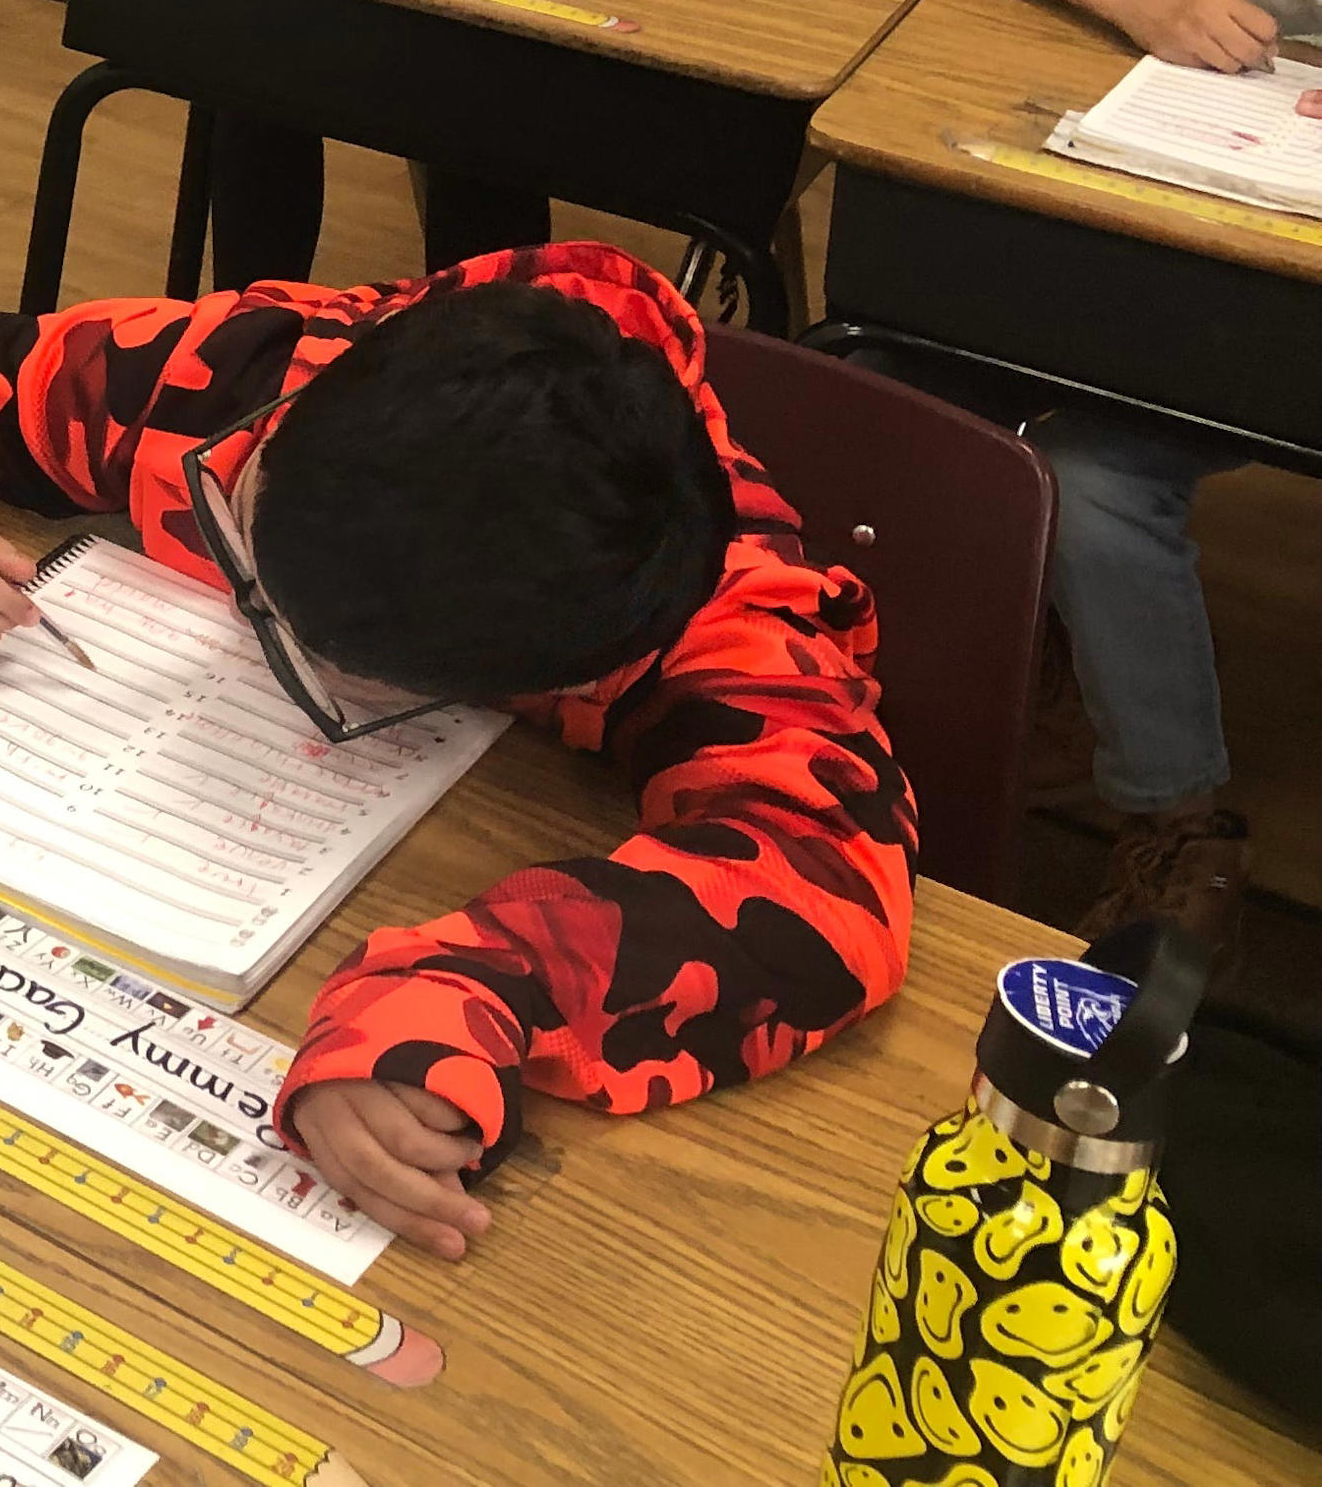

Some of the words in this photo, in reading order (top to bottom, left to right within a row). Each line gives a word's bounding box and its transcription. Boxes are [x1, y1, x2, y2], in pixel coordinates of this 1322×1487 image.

[1032, 962, 1055, 1031] LIBERTY
[1054, 977, 1075, 1030] POINT
[28, 1056, 56, 1079] Hh
[101, 1098, 128, 1120] Ff
[181, 1140, 217, 1165] Dd
[228, 1164, 259, 1187] Cc
[274, 1186, 305, 1211] Bb
[320, 1209, 350, 1233] Aa
[29, 1401, 61, 1429] Nn
